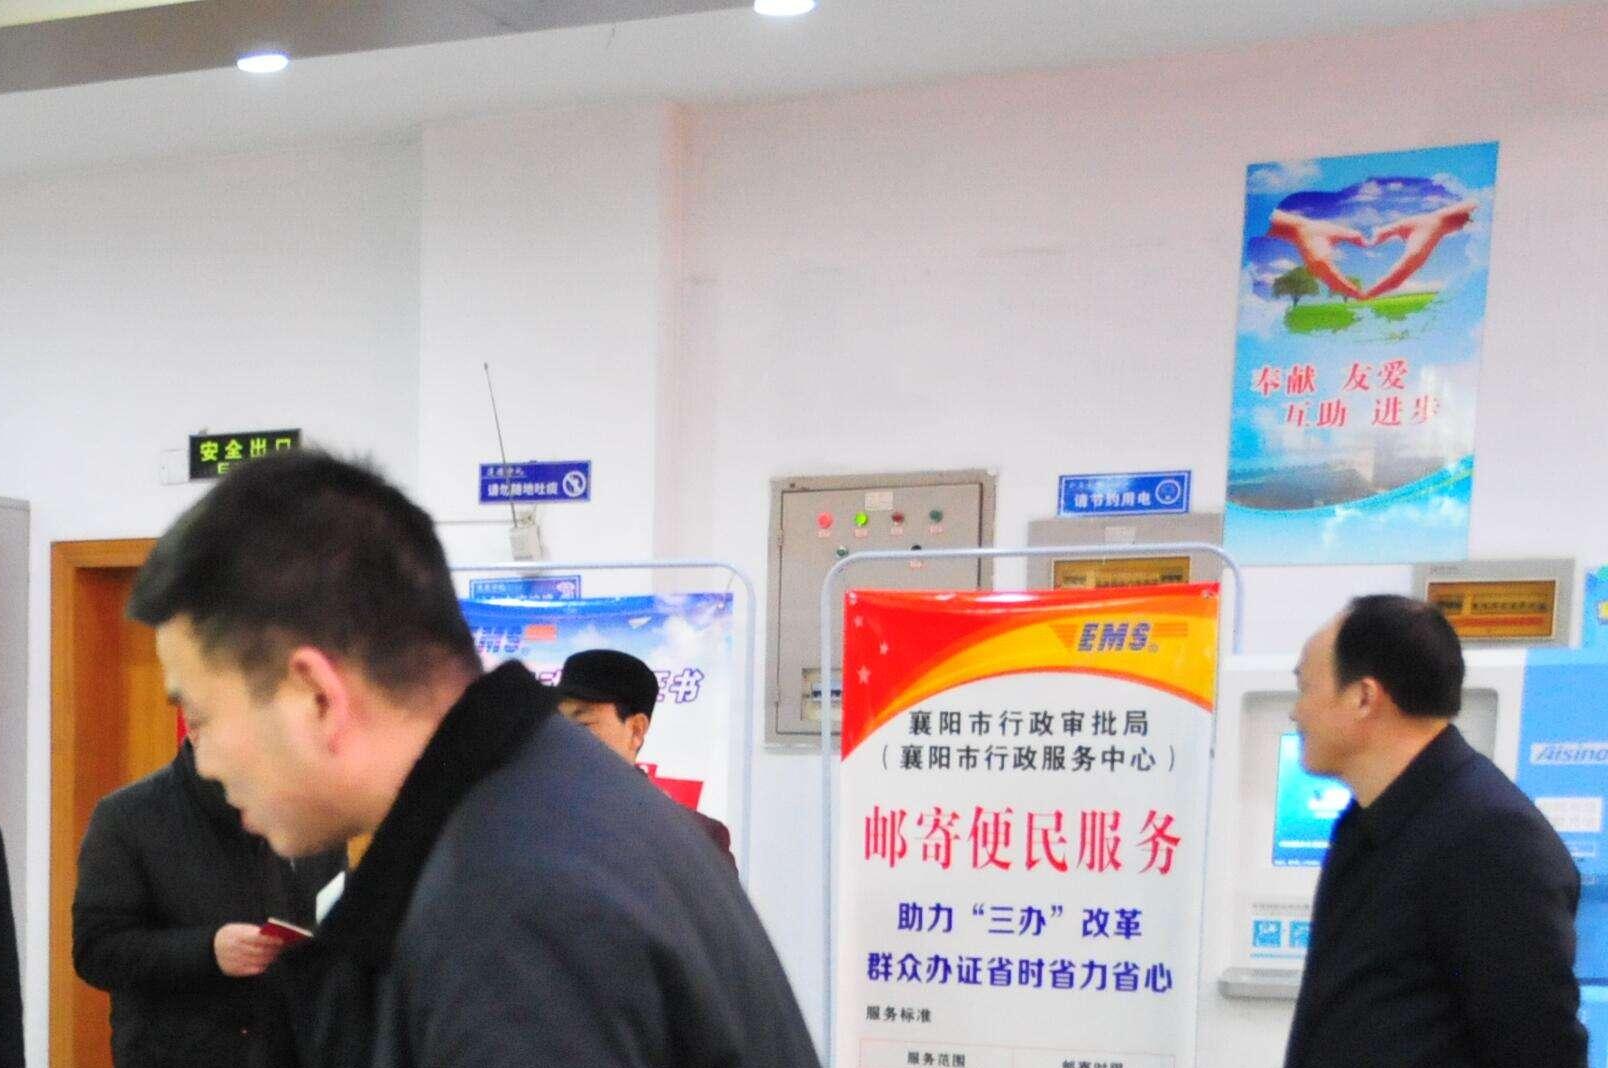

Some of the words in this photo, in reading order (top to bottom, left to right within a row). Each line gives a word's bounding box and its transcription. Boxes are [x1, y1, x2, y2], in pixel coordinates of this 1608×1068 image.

[1255, 364, 1315, 396] 奉献
[1343, 359, 1408, 391] 友爱
[1285, 399, 1348, 428] 互助
[1372, 395, 1441, 427] 进步
[1077, 622, 1152, 653] EMS
[907, 710, 1150, 738] 襄阳市行政审批局
[881, 744, 1176, 772] （襄阳市行政服务中心）
[864, 804, 1182, 876] 邮寄便民服务
[866, 952, 1174, 994] 群众办证省时省力省心
[866, 1005, 933, 1024] 服务标准
[906, 1050, 967, 1068] 服务范围
